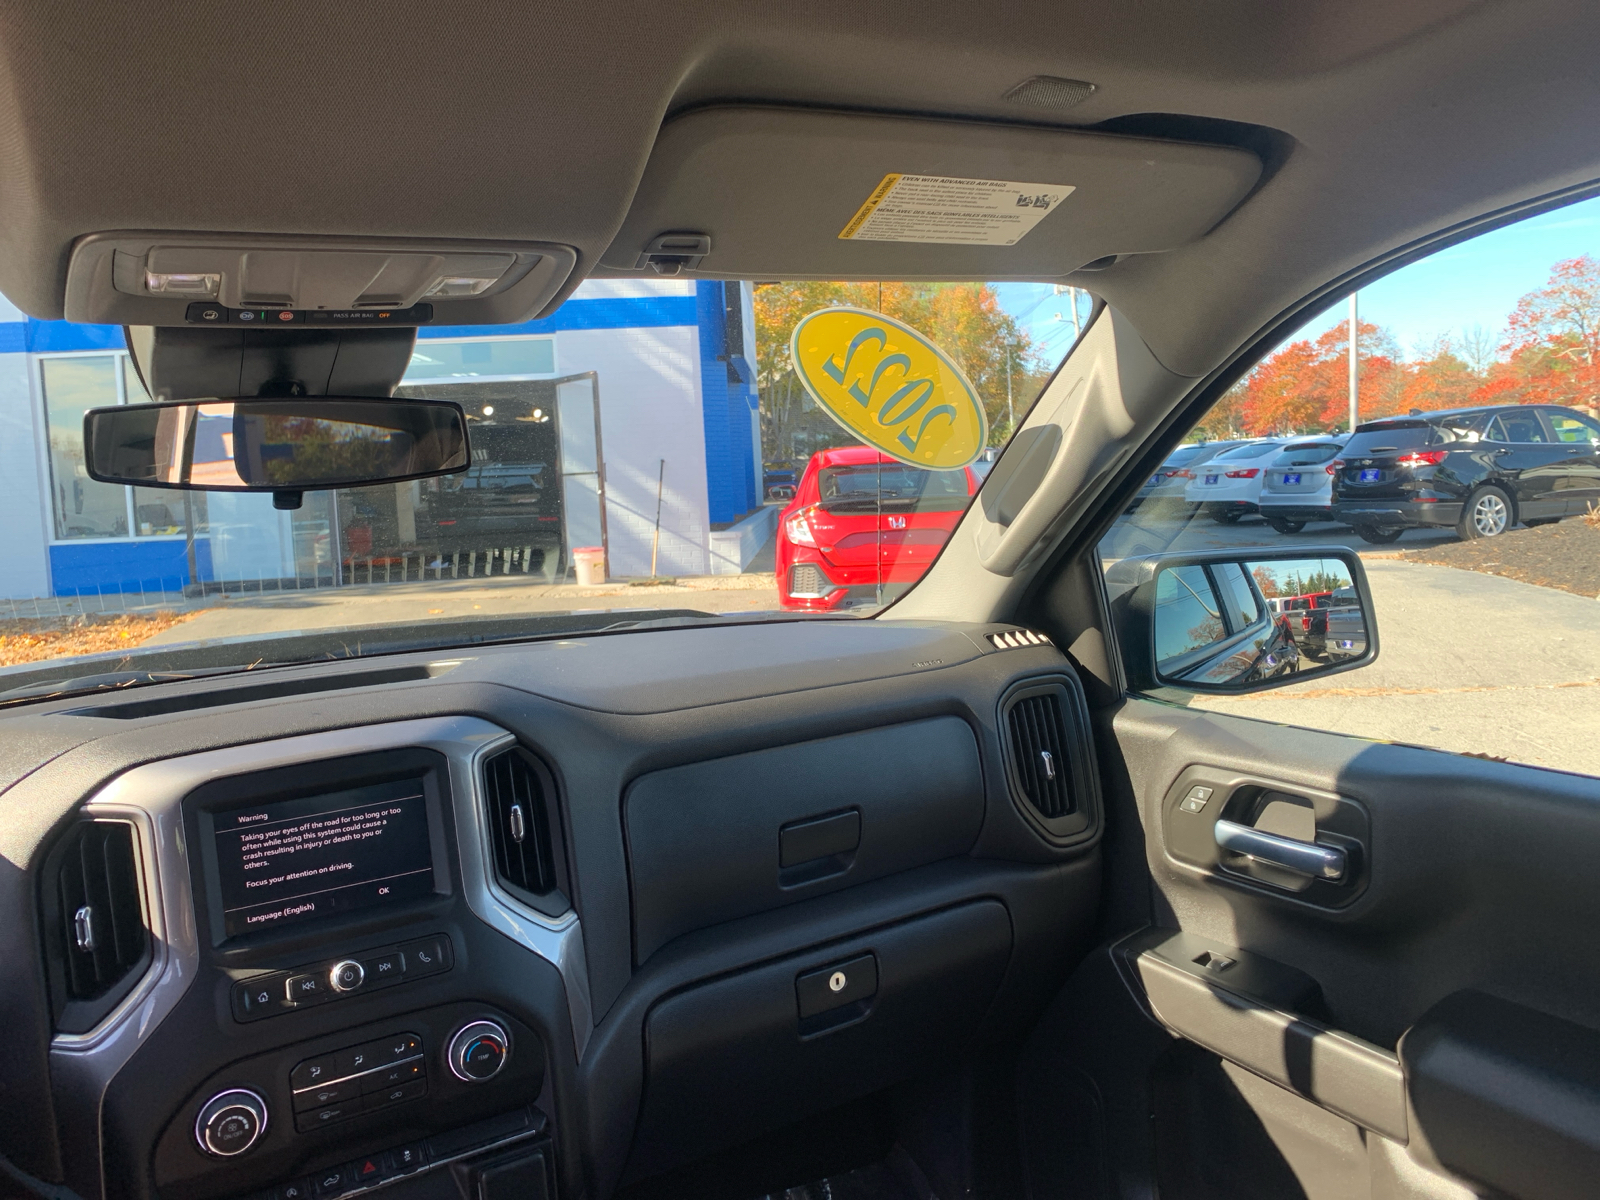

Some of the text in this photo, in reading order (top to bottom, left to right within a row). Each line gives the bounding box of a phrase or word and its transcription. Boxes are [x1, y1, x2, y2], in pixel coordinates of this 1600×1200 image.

[238, 812, 268, 823] Warning
[241, 832, 264, 842] Taking
[265, 829, 281, 840] your
[282, 826, 298, 836] eyes
[300, 822, 311, 831] off
[312, 821, 323, 829] the
[324, 817, 340, 827] road
[341, 816, 351, 824] for
[365, 810, 380, 820] long
[242, 842, 262, 852] often
[263, 837, 282, 847] while
[283, 834, 302, 845] using
[303, 831, 316, 840] this
[317, 826, 341, 837] system
[343, 823, 361, 833] could
[362, 820, 380, 829] cause
[243, 850, 263, 861] crash
[264, 845, 294, 857] resulting
[296, 842, 302, 850] in
[304, 839, 322, 850] injury
[332, 833, 352, 843] death
[362, 830, 374, 840] you
[244, 860, 269, 870] others.
[246, 879, 268, 888] Focus
[269, 875, 284, 885] your
[286, 868, 317, 880] attention
[329, 861, 354, 872] driving.
[379, 887, 389, 895] OK
[247, 903, 315, 923] Language (English)
